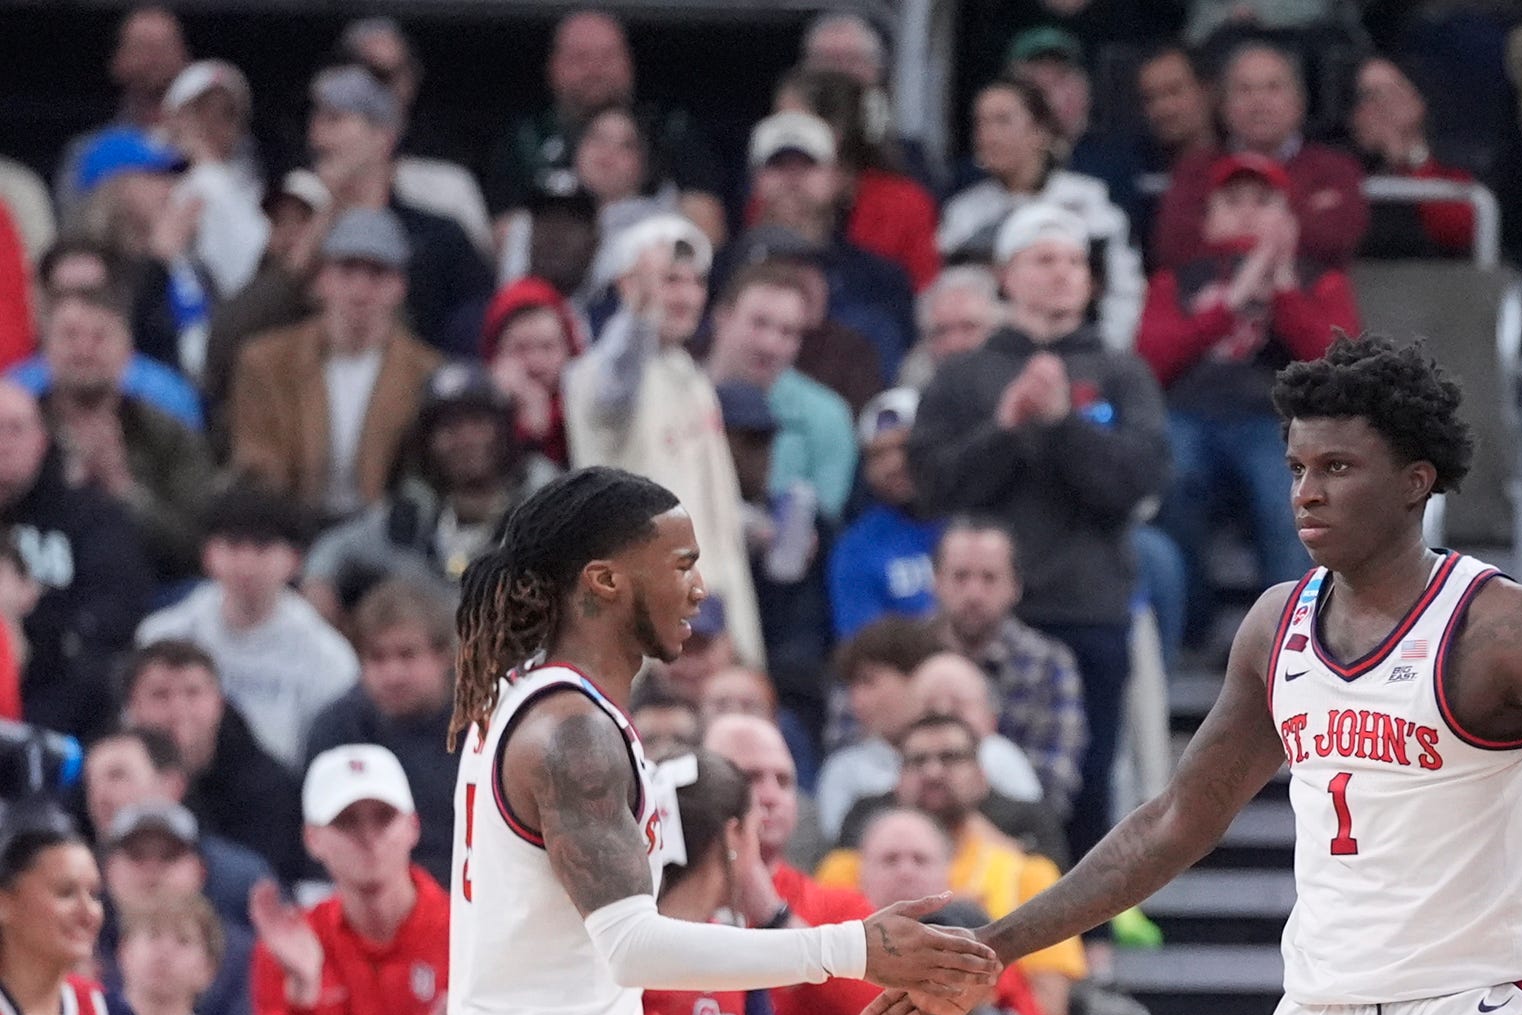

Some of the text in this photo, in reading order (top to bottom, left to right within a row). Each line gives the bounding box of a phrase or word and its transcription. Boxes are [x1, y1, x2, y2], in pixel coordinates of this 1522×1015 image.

[1387, 672, 1418, 682] EAST
[1393, 665, 1413, 674] BIG
[1314, 709, 1443, 771] JOHN'S
[1327, 771, 1359, 856] 1
